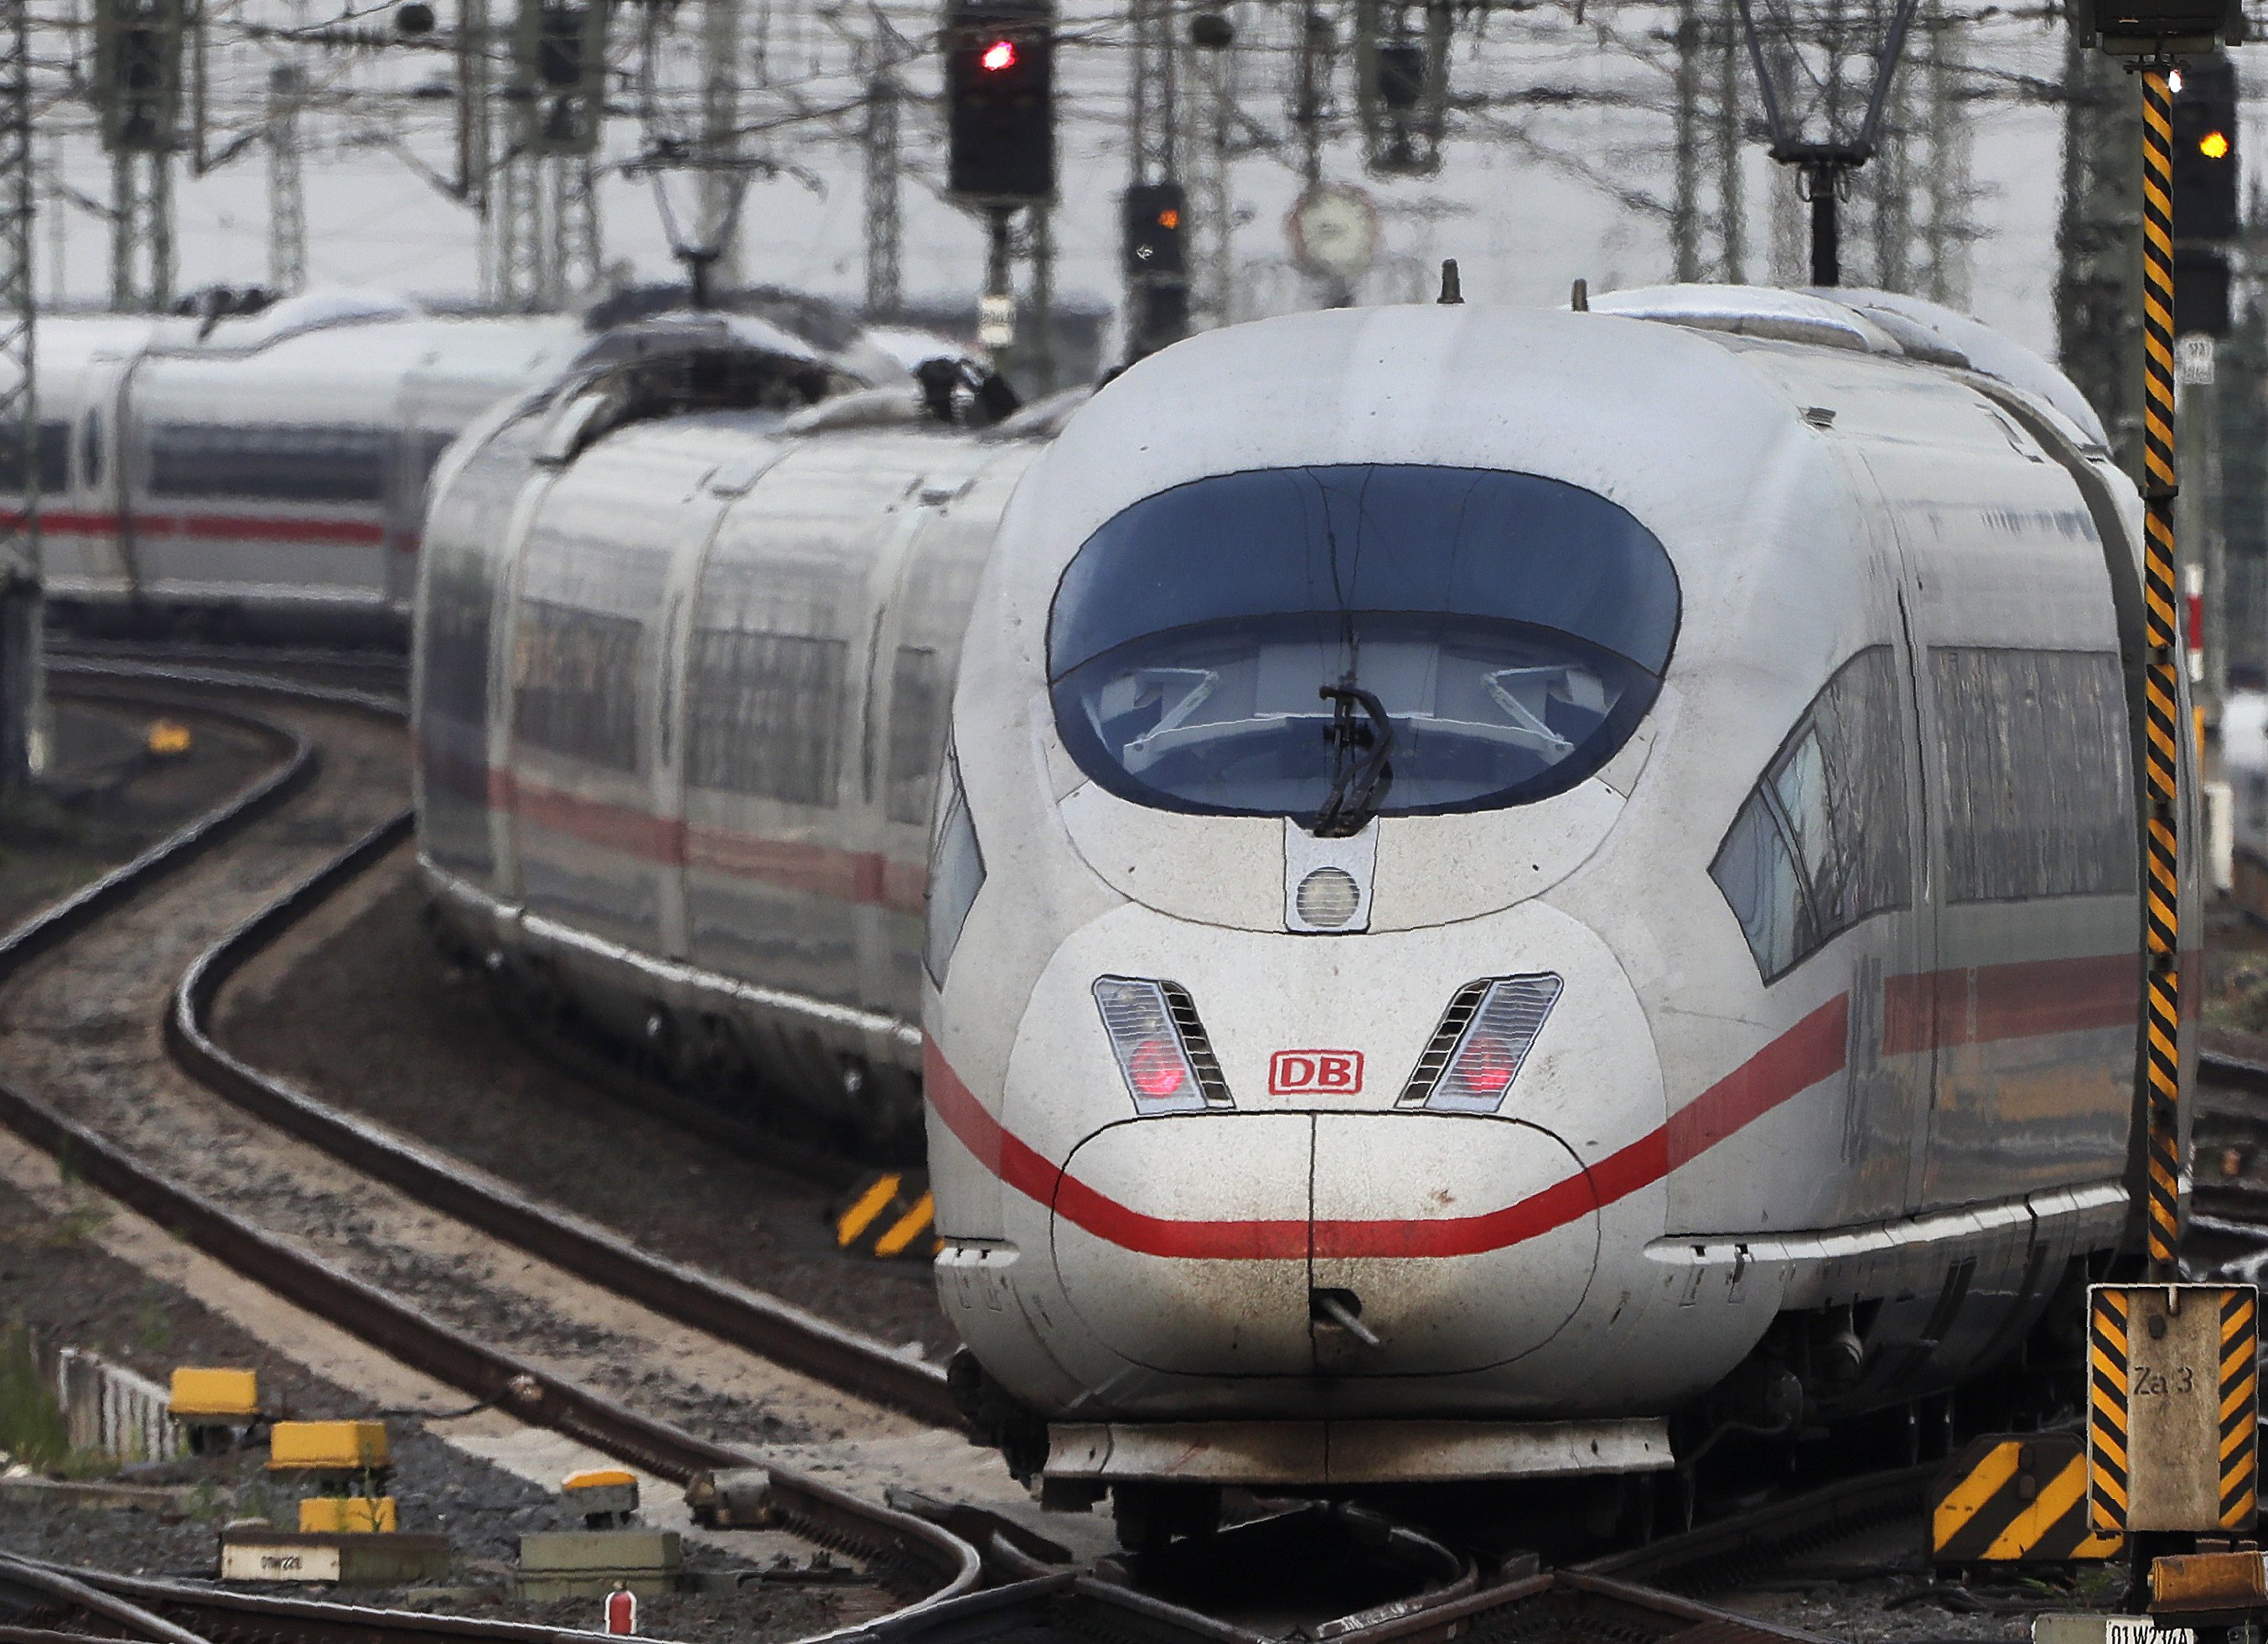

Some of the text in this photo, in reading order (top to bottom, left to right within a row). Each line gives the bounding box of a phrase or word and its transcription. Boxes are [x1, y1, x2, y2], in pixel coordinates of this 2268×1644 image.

[1280, 1056, 1351, 1087] DB
[2133, 1366, 2193, 1395] Za 3
